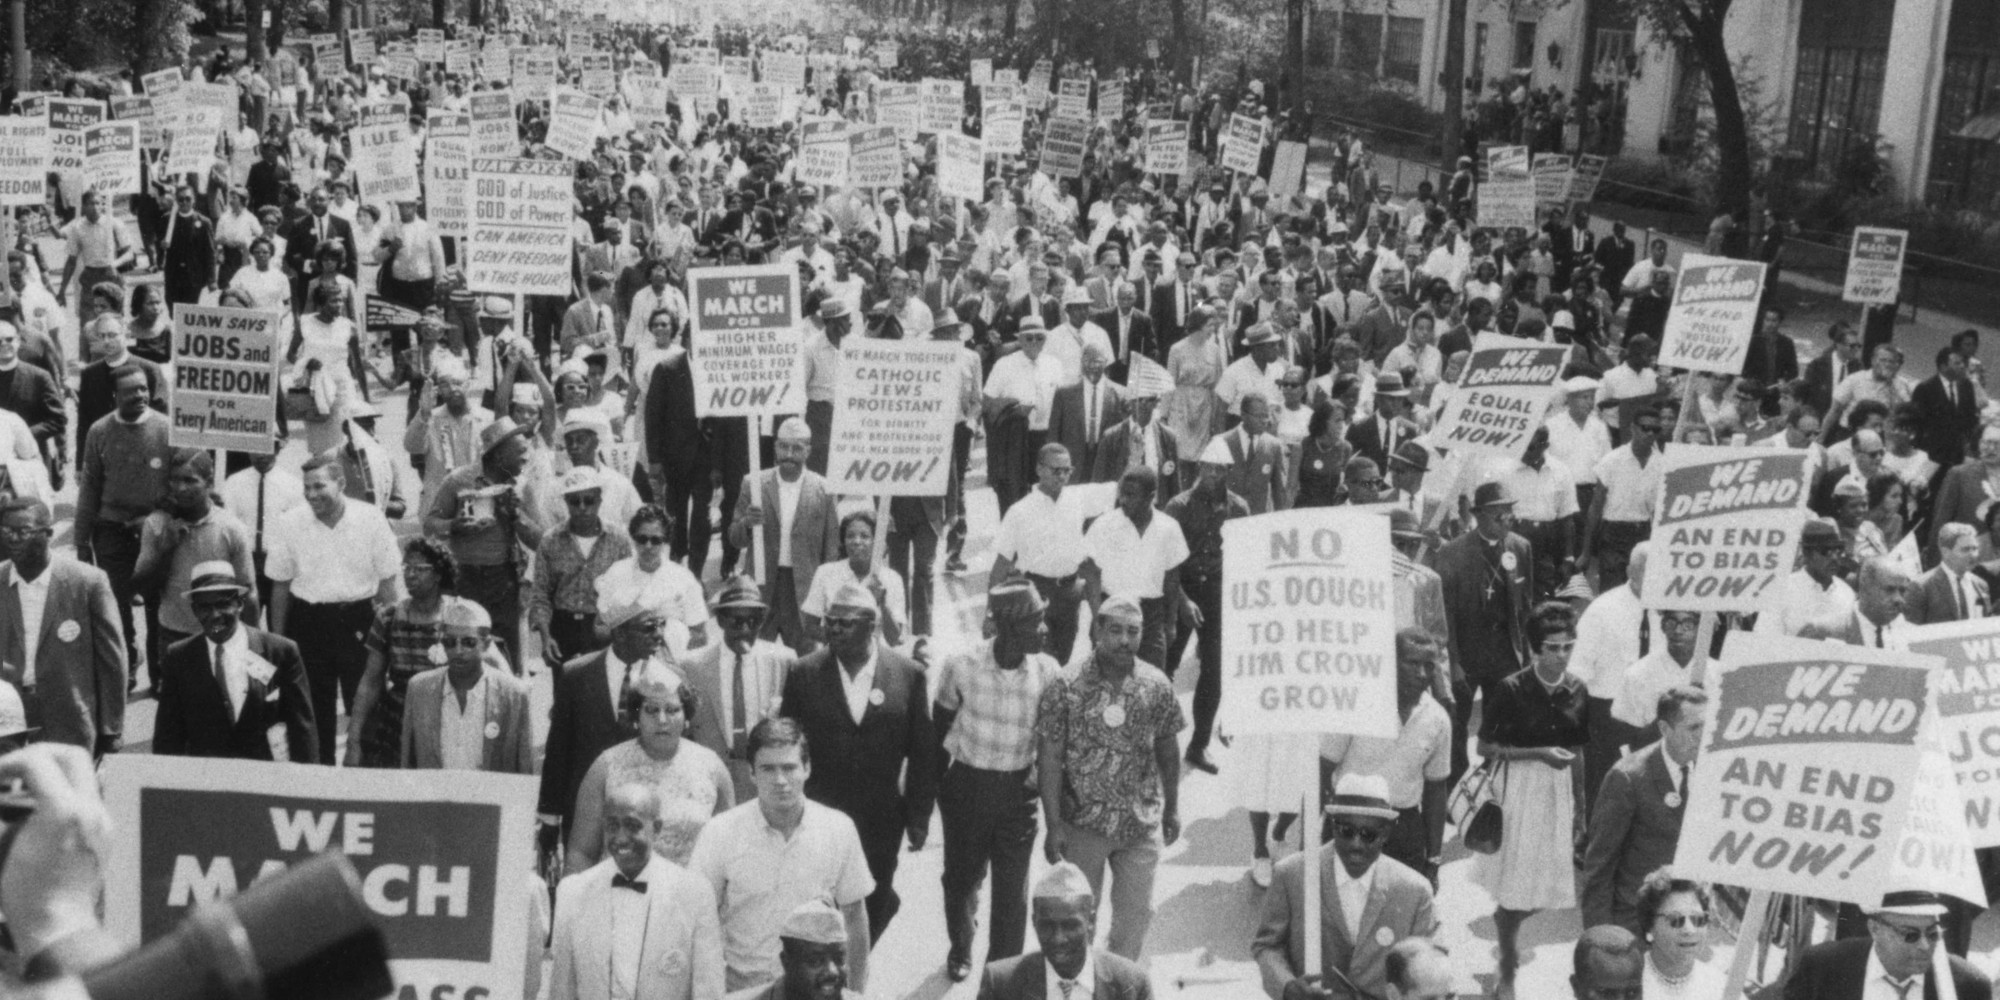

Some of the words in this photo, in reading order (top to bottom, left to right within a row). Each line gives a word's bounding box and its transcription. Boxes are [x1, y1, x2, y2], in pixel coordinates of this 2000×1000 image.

[932, 84, 951, 94] NO
[52, 112, 98, 123] MARCH
[68, 105, 83, 114] WE
[12, 126, 46, 136] RIGHTS
[478, 122, 511, 135] JOBS
[1047, 130, 1072, 141] JOBS
[53, 133, 82, 146] JO
[88, 135, 132, 150] MARCH
[0, 157, 43, 166] LOYMENT
[477, 179, 505, 197] GOD
[510, 181, 525, 199] of
[477, 201, 505, 219] GOD
[510, 204, 525, 220] of
[474, 230, 505, 242] CAN
[506, 232, 566, 245] AMERICA
[1859, 242, 1899, 254] MARCH
[473, 250, 507, 263] DENY
[508, 251, 567, 265] FREEDOM
[473, 271, 487, 281] IN
[490, 271, 519, 284] THIS
[523, 273, 569, 286] HOUR?
[1705, 265, 1740, 282] WE
[728, 278, 757, 296] WE
[1680, 279, 1758, 300] DEMAND
[1851, 285, 1892, 298] NOW!
[703, 295, 785, 316] MARCH
[1683, 306, 1708, 317] AN
[1710, 309, 1742, 321] END
[184, 313, 223, 328] UAW
[226, 317, 268, 332] SAYS
[728, 317, 761, 327] FOR
[1692, 321, 1727, 335] POLICE
[717, 331, 777, 344] HIGHER
[178, 333, 241, 360] JOBS
[243, 345, 270, 363] and
[698, 345, 753, 358] MINIMUM
[757, 343, 798, 356] WAGES
[845, 350, 860, 361] WE
[863, 350, 900, 362] MARCH
[904, 352, 956, 363] TOGETHER
[1673, 342, 1740, 361] NOW!
[703, 359, 766, 371] COVERAGE
[770, 357, 795, 369] FOR
[1500, 349, 1540, 366] WE
[177, 366, 270, 395] FREEDOM
[707, 373, 729, 384] ALL
[731, 369, 791, 382] WORKERS
[856, 367, 942, 383] CATHOLIC
[1467, 364, 1557, 384] DEMAND
[710, 382, 791, 409] NOW!
[870, 384, 923, 397] JEWS
[208, 399, 236, 409] FOR
[848, 397, 943, 413] PROTESTANT
[1468, 391, 1532, 414] EQUAL
[174, 407, 206, 433] Every
[209, 410, 267, 433] American
[861, 418, 880, 428] FOR
[885, 419, 927, 428] DIGNITY
[1459, 408, 1529, 431] RIGHTS
[841, 431, 863, 441] AND
[868, 432, 942, 442] BROTHERHOOD
[1448, 425, 1524, 449] NOW!
[869, 445, 889, 455] MEN
[844, 456, 939, 482] NOW!
[1709, 459, 1763, 488] WE
[1668, 478, 1798, 519] DEMAND
[1270, 528, 1342, 561] NO
[1670, 528, 1714, 546] AN
[1723, 528, 1786, 547] END
[1669, 551, 1706, 569] TO
[1714, 551, 1778, 570] BIAS
[1232, 579, 1278, 611] U.S.
[1285, 577, 1385, 611] DOUGH
[1664, 572, 1776, 598] NOW!
[1248, 620, 1285, 645] TO
[1296, 618, 1369, 645] HELP
[1232, 651, 1285, 678] JIM
[1296, 649, 1383, 678] CROW
[1785, 663, 1869, 700] WE
[1259, 684, 1359, 711] GROW
[1722, 698, 1918, 741] DEMAND
[1720, 756, 1787, 790] AN
[1799, 765, 1895, 804] END
[1720, 791, 1773, 824] TO
[1783, 801, 1883, 840] BIAS
[269, 806, 375, 855] WE
[1708, 830, 1876, 880] NOW!
[166, 854, 471, 918] MCH
